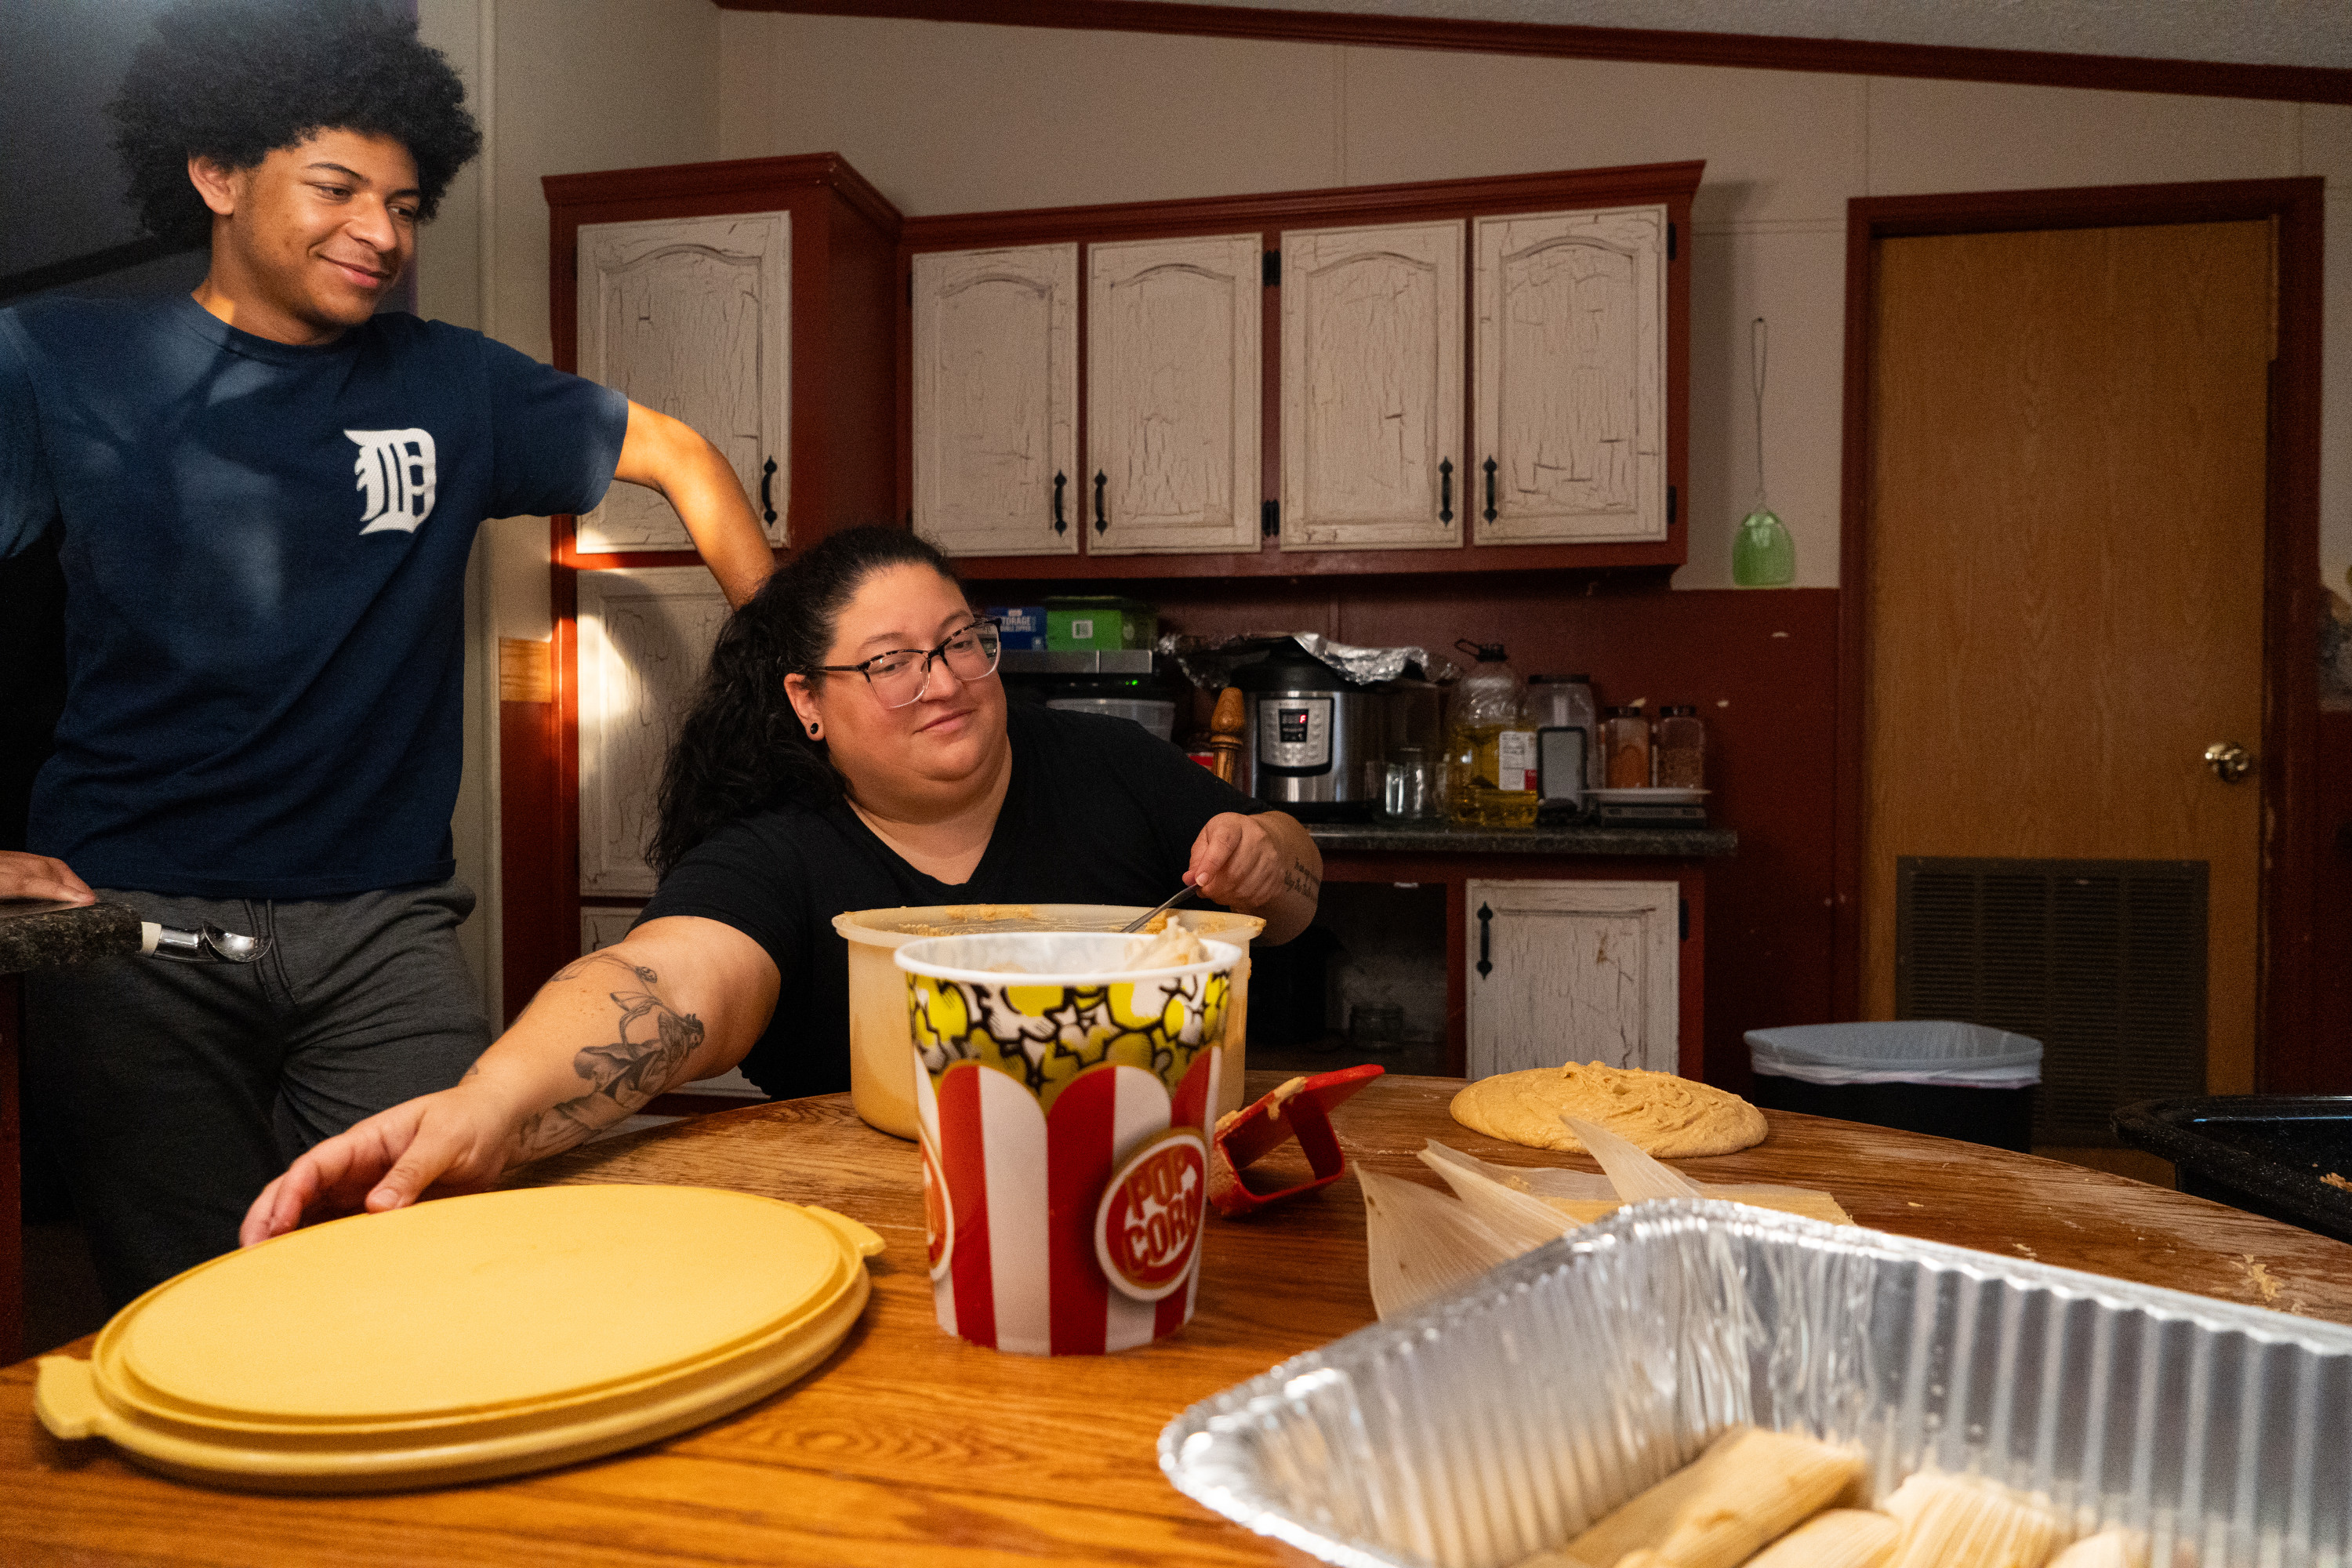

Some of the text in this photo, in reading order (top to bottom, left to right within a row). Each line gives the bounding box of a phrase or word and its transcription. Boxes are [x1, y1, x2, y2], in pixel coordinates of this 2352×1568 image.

[343, 428, 437, 535] D
[1125, 1148, 1186, 1220] POP
[1124, 1189, 1197, 1272] CORN
